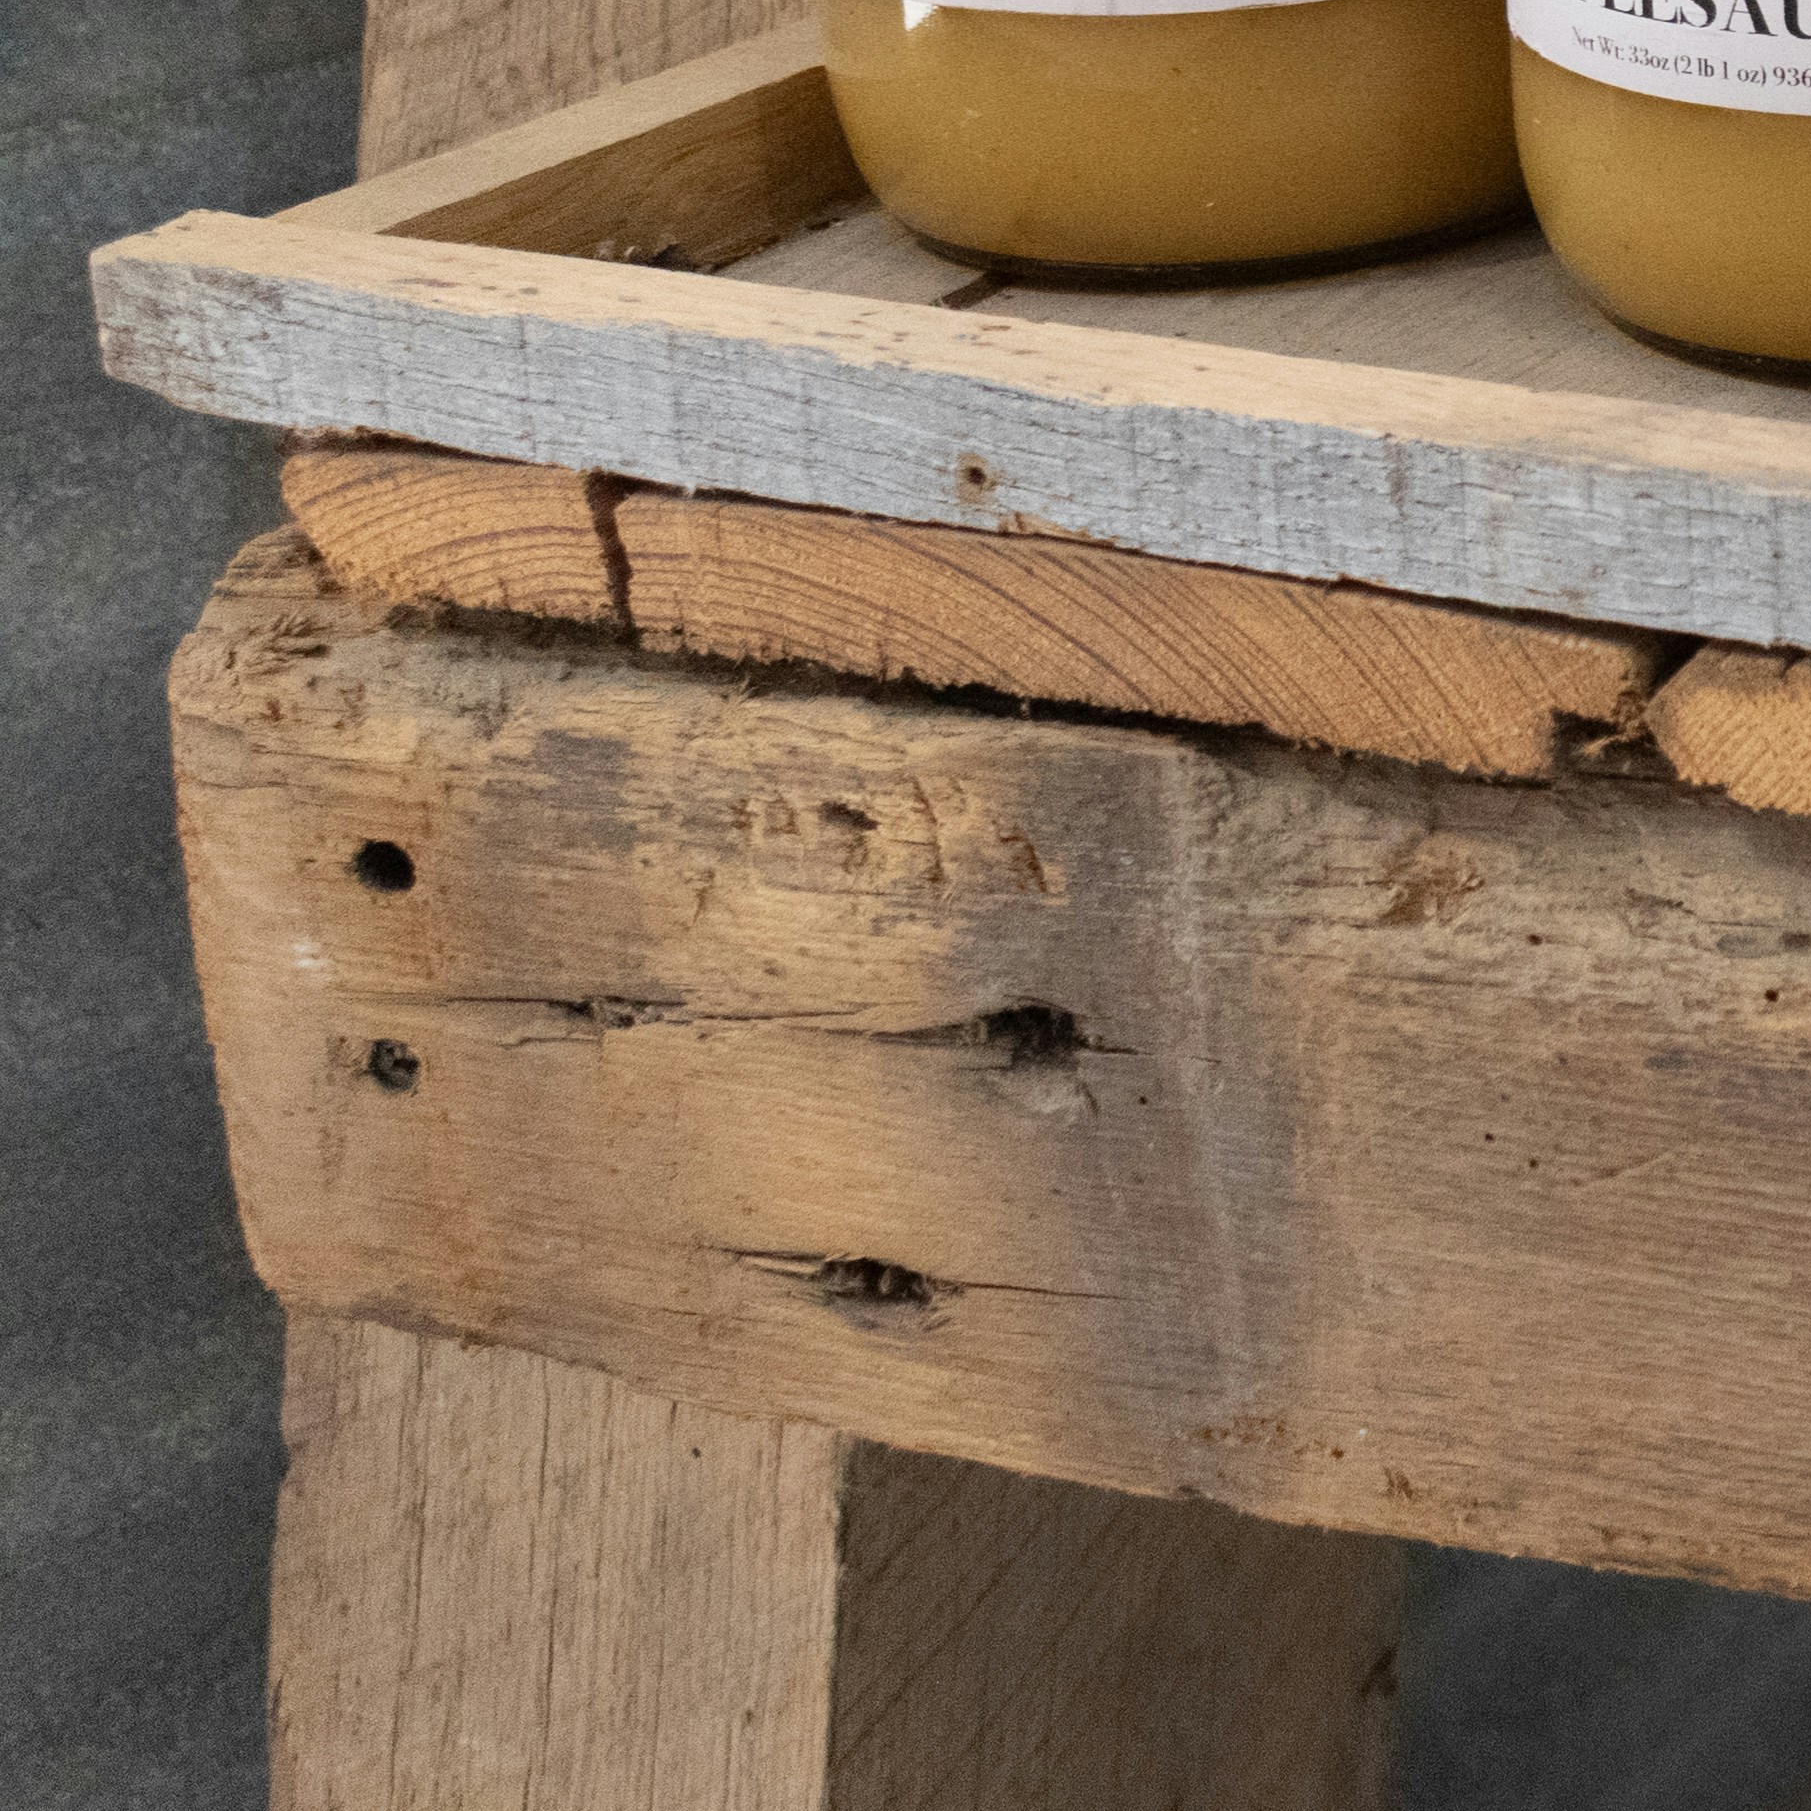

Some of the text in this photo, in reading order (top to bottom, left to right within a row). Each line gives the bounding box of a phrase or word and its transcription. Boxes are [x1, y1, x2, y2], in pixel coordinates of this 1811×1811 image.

[1626, 43, 1671, 72] 33oz
[1672, 52, 1693, 77] (2
[1697, 57, 1716, 80] lb
[1737, 64, 1768, 88] oz)
